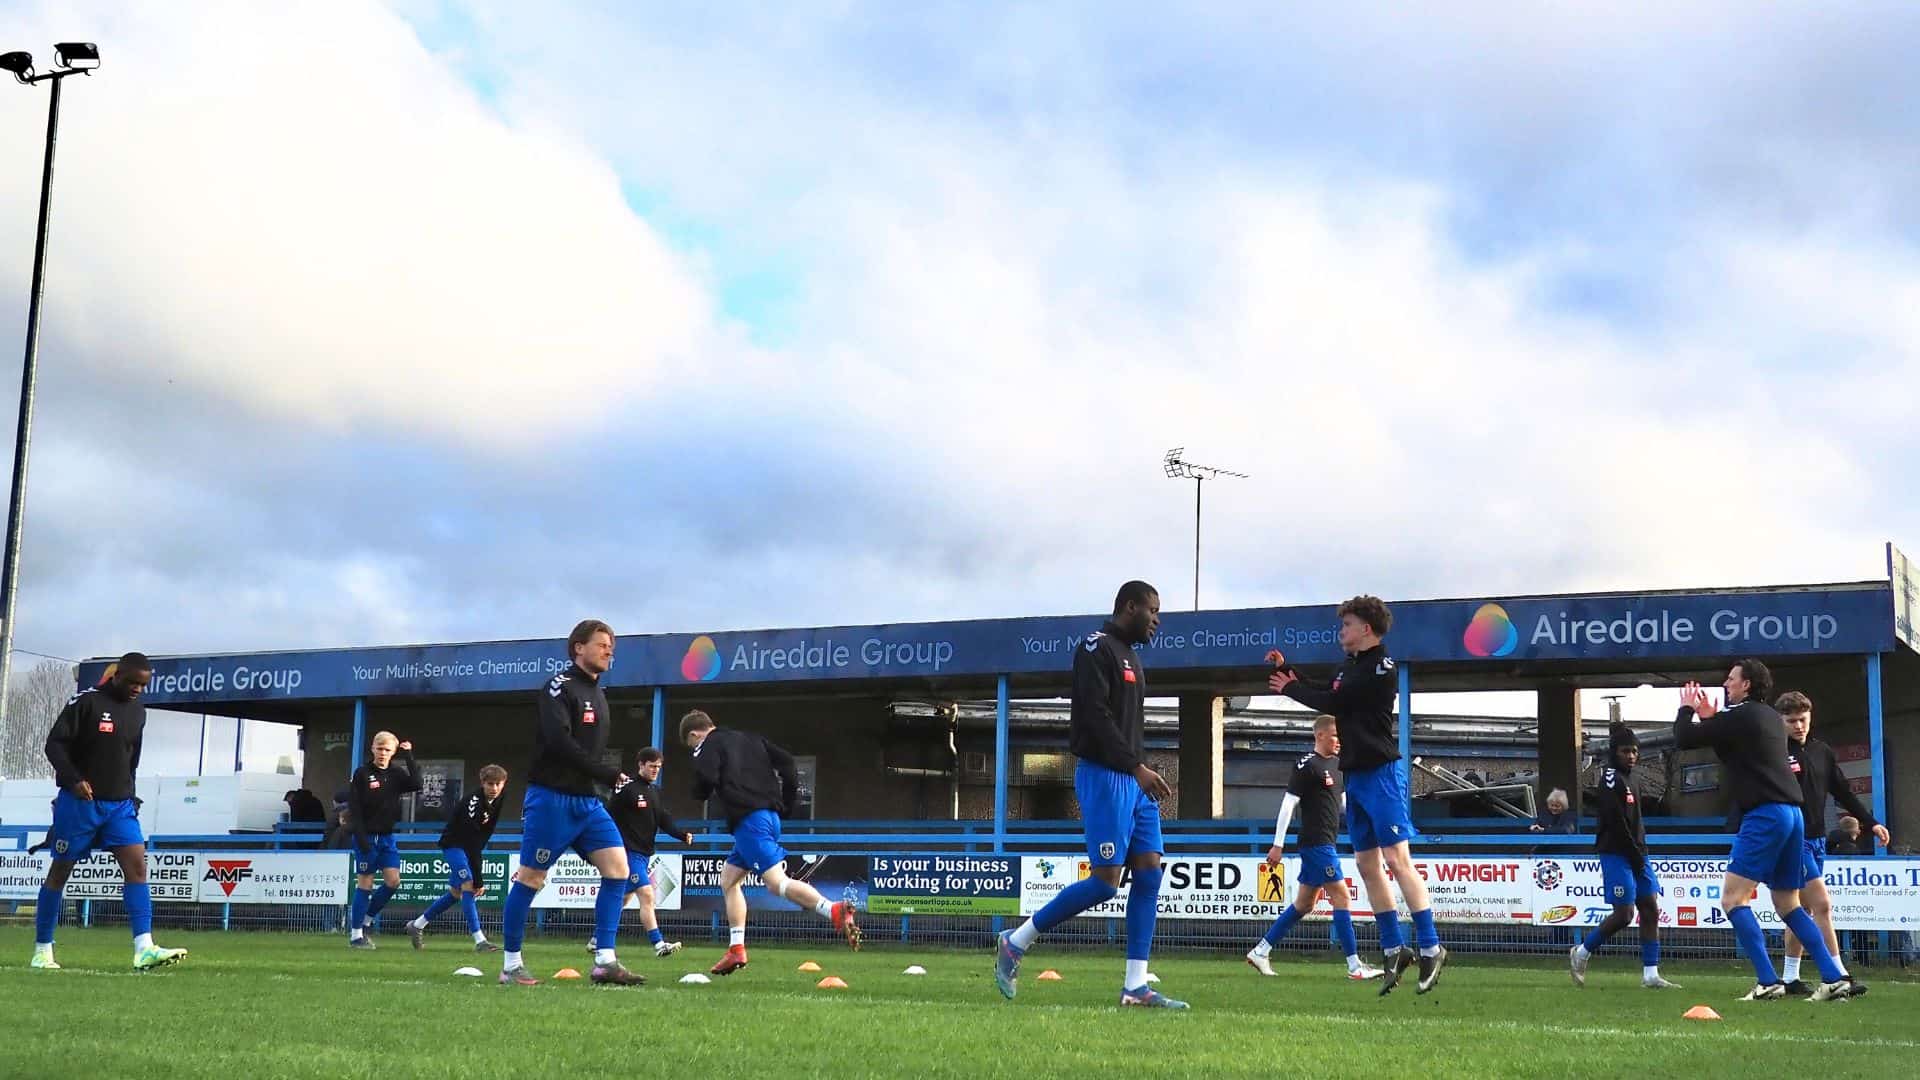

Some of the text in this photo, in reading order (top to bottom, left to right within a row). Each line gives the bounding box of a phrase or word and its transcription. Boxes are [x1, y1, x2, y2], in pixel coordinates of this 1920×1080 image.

[1530, 608, 1838, 649] Airedale Group
[1021, 637, 1061, 654] Your
[1192, 626, 1276, 648] Chemical
[729, 637, 954, 671] Airedale Group
[352, 665, 382, 681] Your
[385, 660, 474, 679] Multi-Service
[478, 656, 541, 675] Chemical
[144, 664, 303, 695] iredale Group
[0, 856, 43, 871] Building
[154, 855, 195, 866] YOUR
[399, 859, 429, 874] ilson
[684, 859, 714, 872] WE'VE
[873, 857, 1009, 875] Is your business
[72, 868, 189, 880] COMPA HERE
[203, 868, 345, 884] AMF BAKERY SYSTEMS
[565, 868, 590, 876] DOOR
[1435, 863, 1520, 882] WRIGHT
[1824, 866, 1899, 887] aildon
[684, 872, 706, 886] PICK
[873, 876, 940, 893] working
[945, 875, 970, 889] for
[972, 876, 1013, 894] you?
[66, 884, 97, 894] CALL:
[150, 887, 165, 895] 36
[170, 887, 192, 896] 162
[279, 889, 303, 898] 01943
[305, 889, 335, 898] 875703
[559, 885, 586, 896] 01943
[1427, 885, 1467, 894] ildon Ltd
[1566, 886, 1606, 897] FOLLO
[1844, 887, 1869, 896] Travel
[1869, 887, 1903, 897] Tailored
[1904, 888, 1918, 897] For
[1190, 893, 1212, 902] 0113
[1213, 893, 1230, 902] 250
[1232, 894, 1254, 903] 1702
[1156, 904, 1180, 914] CAL
[1185, 904, 1229, 914] OLDER
[1233, 905, 1285, 916] PEOPLE
[1754, 911, 1782, 923] XBO
